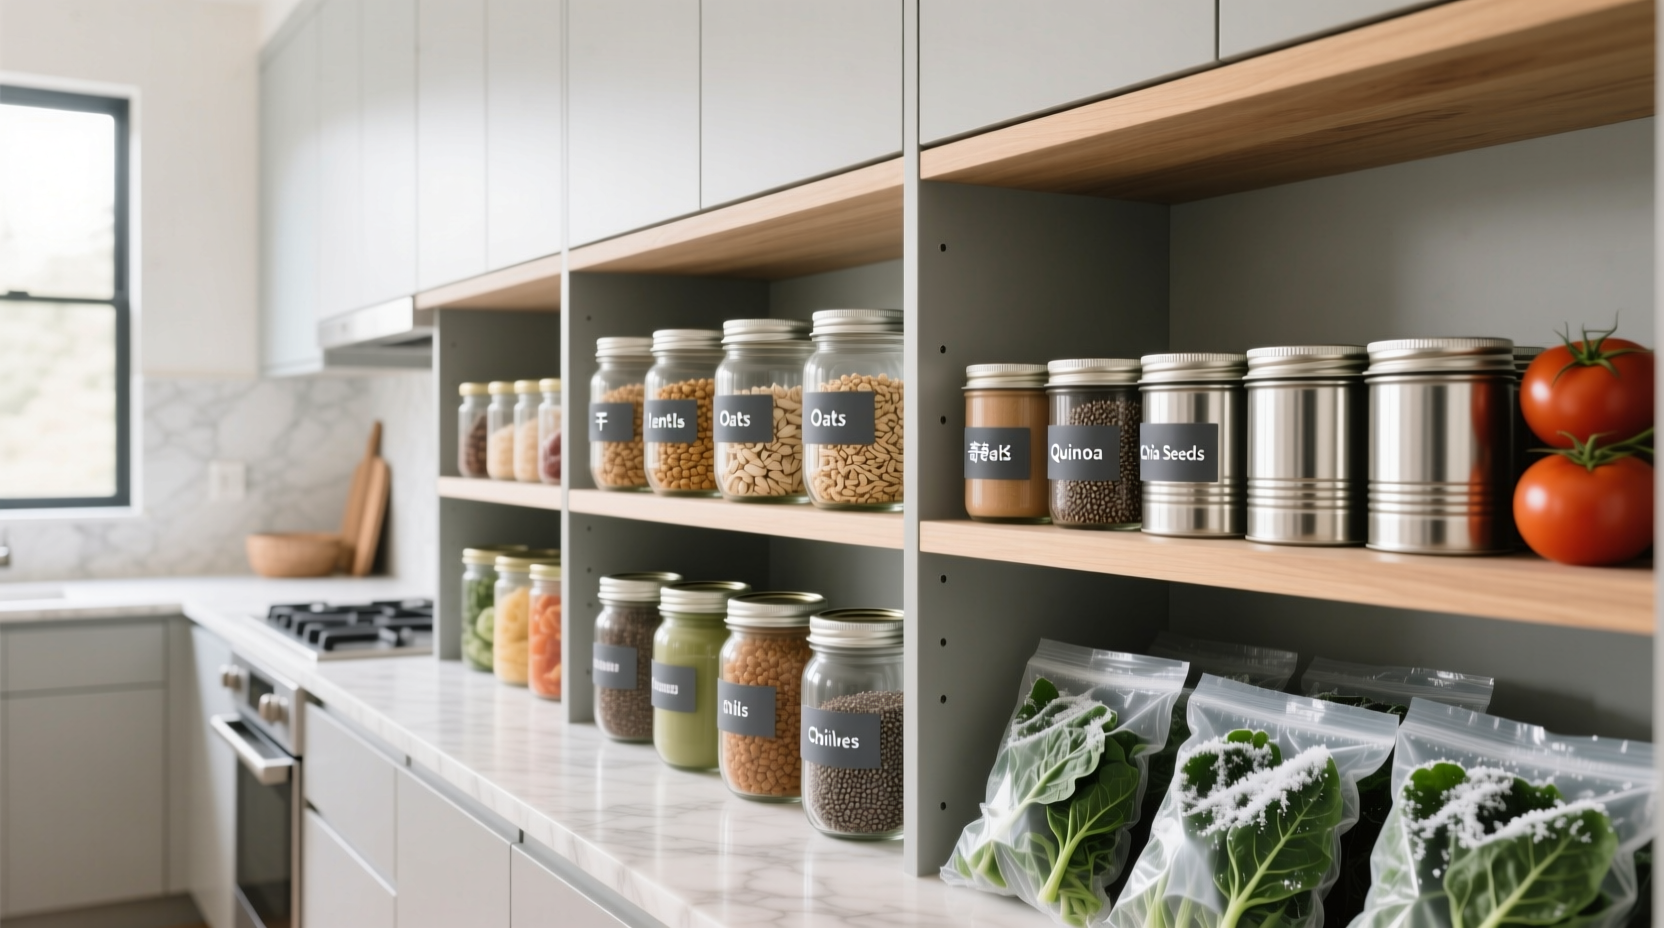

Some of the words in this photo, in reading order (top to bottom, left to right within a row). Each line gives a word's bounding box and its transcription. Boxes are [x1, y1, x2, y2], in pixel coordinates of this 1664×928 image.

[720, 410, 751, 427] Oats
[811, 409, 846, 427] Oats
[1051, 443, 1103, 463] Quinoa
[1163, 445, 1205, 461] Seeds
